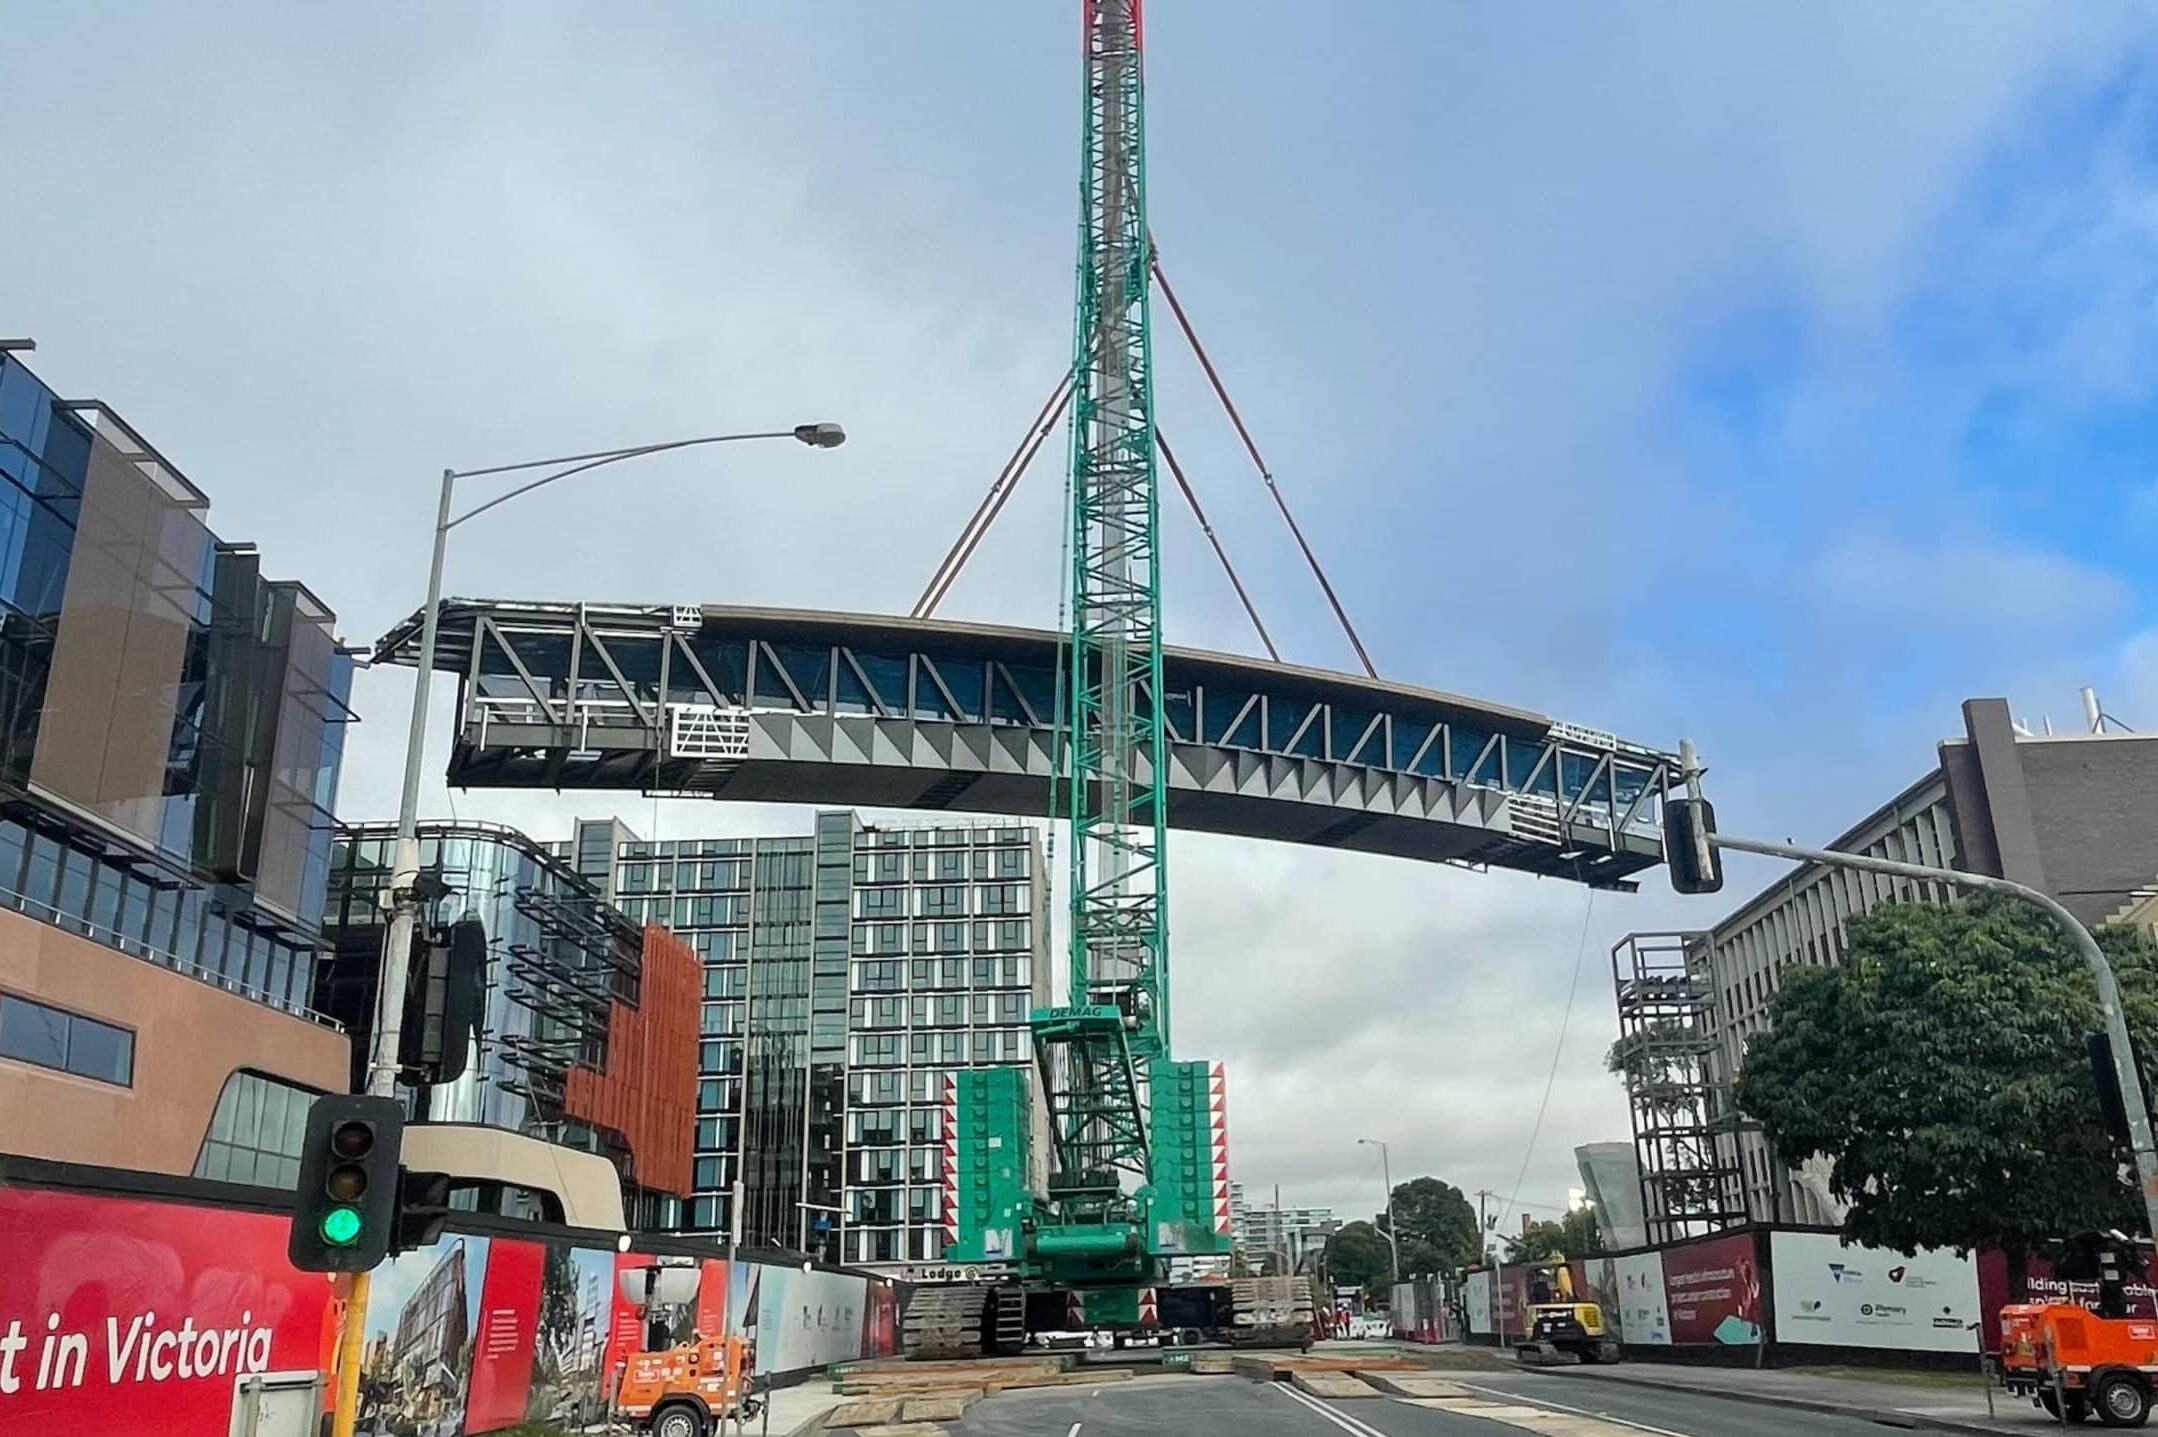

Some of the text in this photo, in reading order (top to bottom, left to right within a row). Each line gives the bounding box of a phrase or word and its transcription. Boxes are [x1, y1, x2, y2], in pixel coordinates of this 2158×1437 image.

[1049, 1006, 1102, 1018] DEMAG
[35, 1312, 88, 1390] in
[107, 1310, 272, 1384] Victoria
